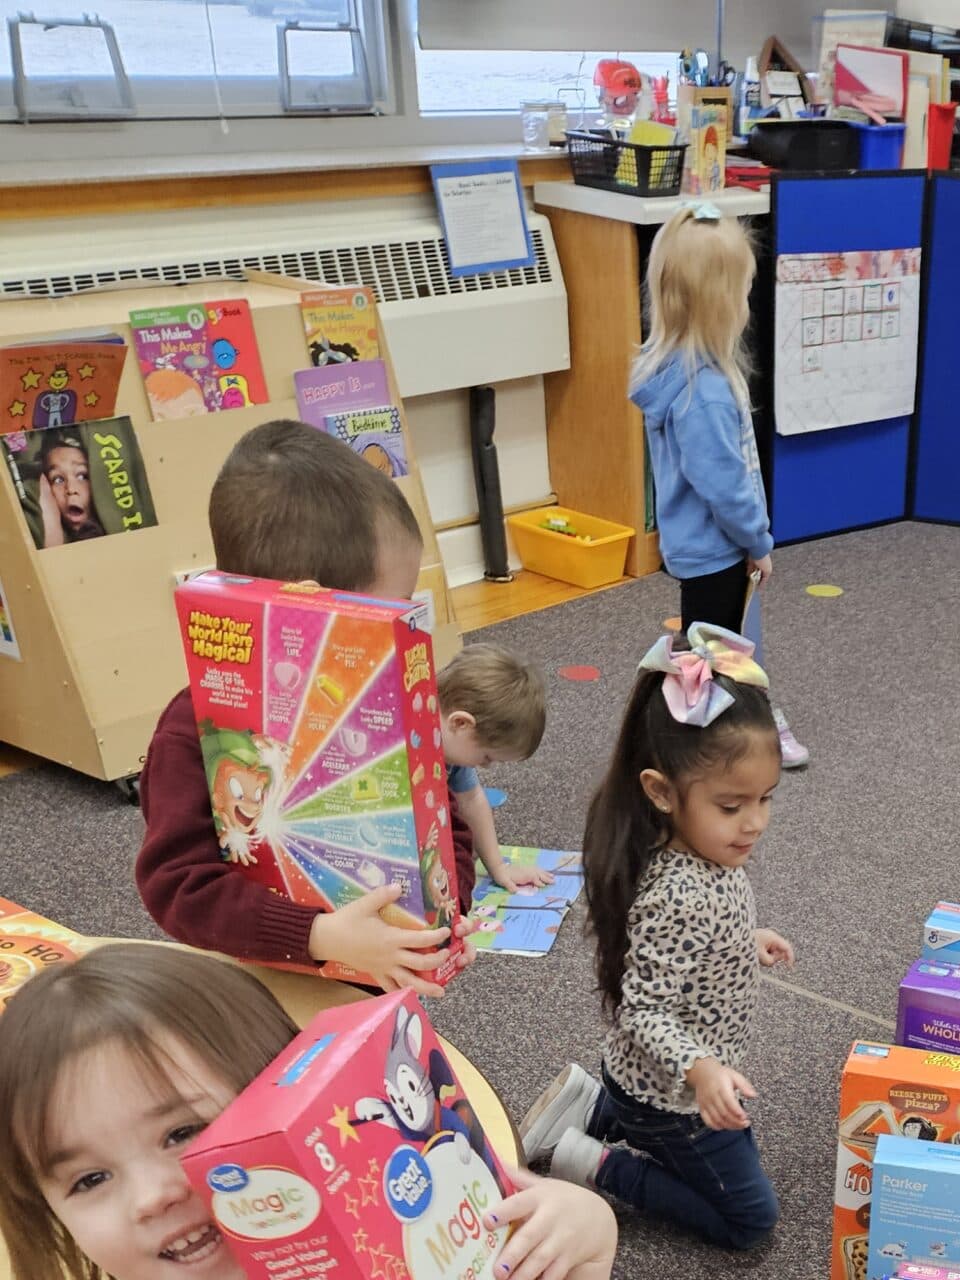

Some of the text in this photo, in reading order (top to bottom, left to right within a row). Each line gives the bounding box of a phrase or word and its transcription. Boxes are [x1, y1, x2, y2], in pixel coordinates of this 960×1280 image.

[139, 326, 192, 343] This Makes
[161, 341, 207, 356] Me Angry
[93, 433, 134, 509] SCARED
[190, 611, 252, 634] Make Your
[188, 625, 254, 648] World More
[193, 640, 251, 664] Magical
[890, 1089, 948, 1103] REESE'S PUFFS
[905, 1099, 940, 1111] pizza?
[313, 1141, 337, 1173] 8
[388, 1157, 424, 1202] Great
[881, 1174, 929, 1193] Parker
[227, 1187, 305, 1218] Magic
[425, 1179, 490, 1275] Magic
[265, 1248, 328, 1271] Great Value
